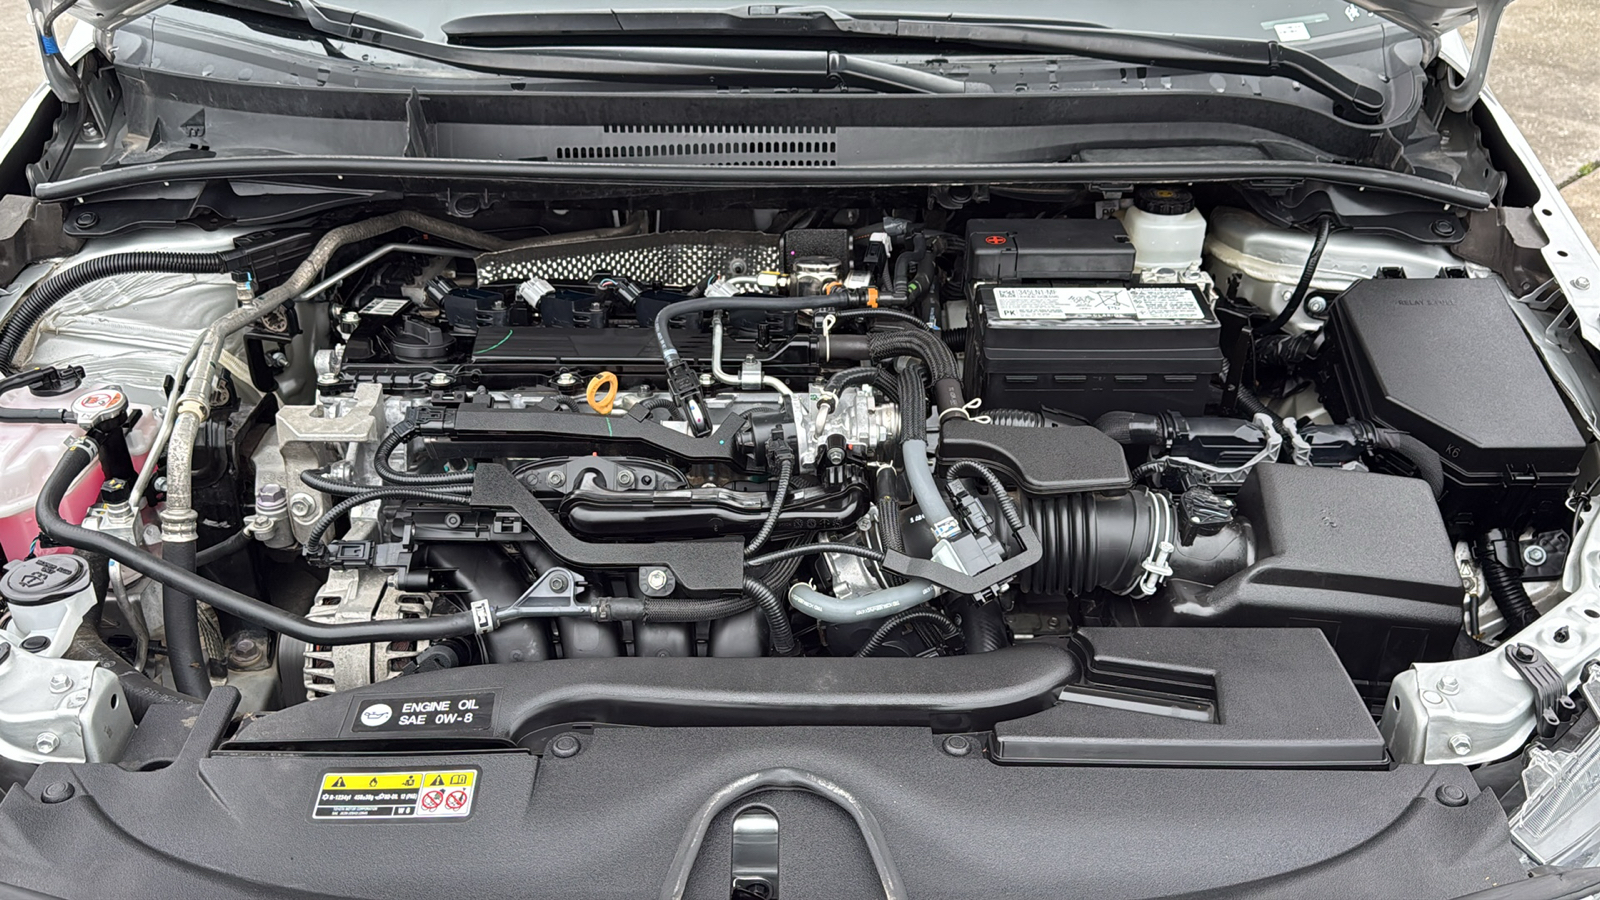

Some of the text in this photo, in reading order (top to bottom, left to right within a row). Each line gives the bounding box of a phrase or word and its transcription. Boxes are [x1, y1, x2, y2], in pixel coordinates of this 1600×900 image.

[1445, 443, 1461, 458] K6
[401, 699, 479, 713] ENGINE OIL
[398, 712, 473, 725] SAE 0W-8
